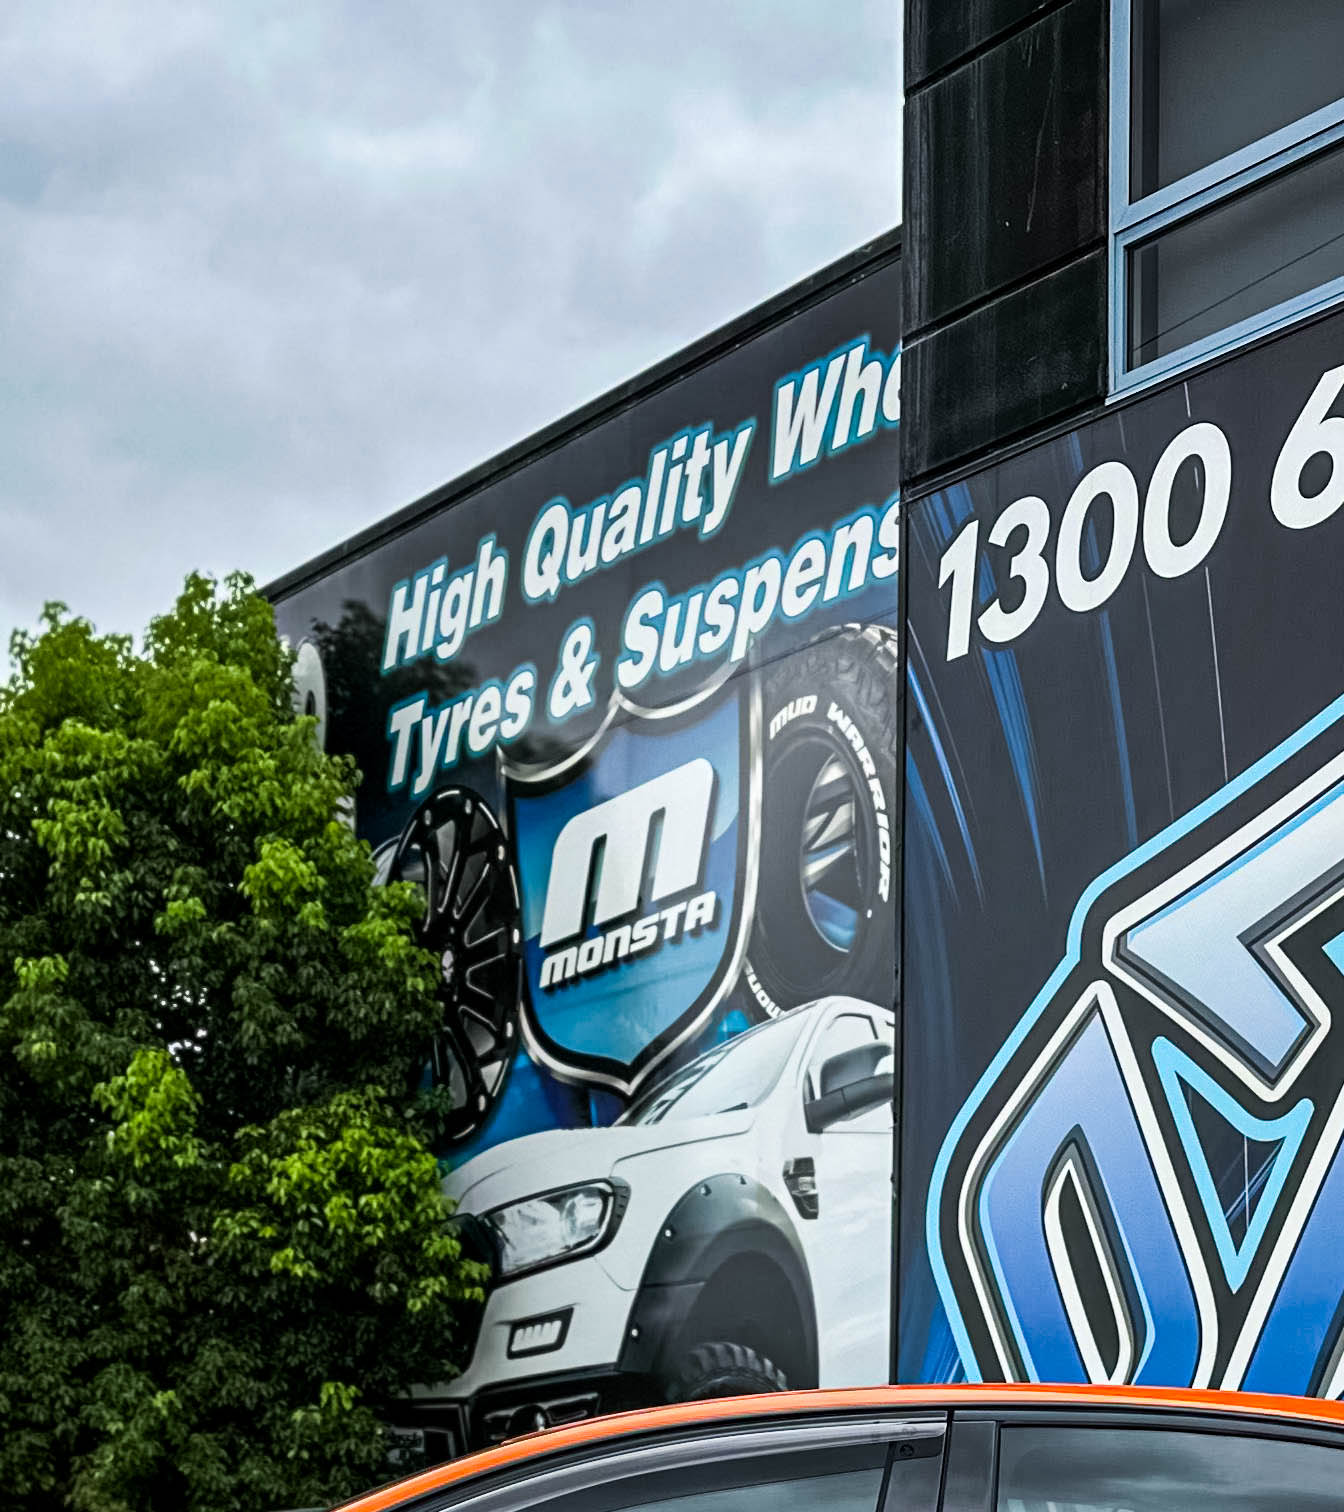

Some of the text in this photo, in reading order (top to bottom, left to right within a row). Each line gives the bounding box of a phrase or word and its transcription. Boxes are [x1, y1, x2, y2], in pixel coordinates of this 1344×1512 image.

[384, 540, 507, 670] High
[524, 424, 753, 596] Quality
[939, 423, 1232, 662] 1300
[390, 671, 535, 794] Tyres
[549, 624, 598, 718] &
[769, 695, 892, 904] MUD WARRIOR
[538, 891, 717, 989] MONSTA
